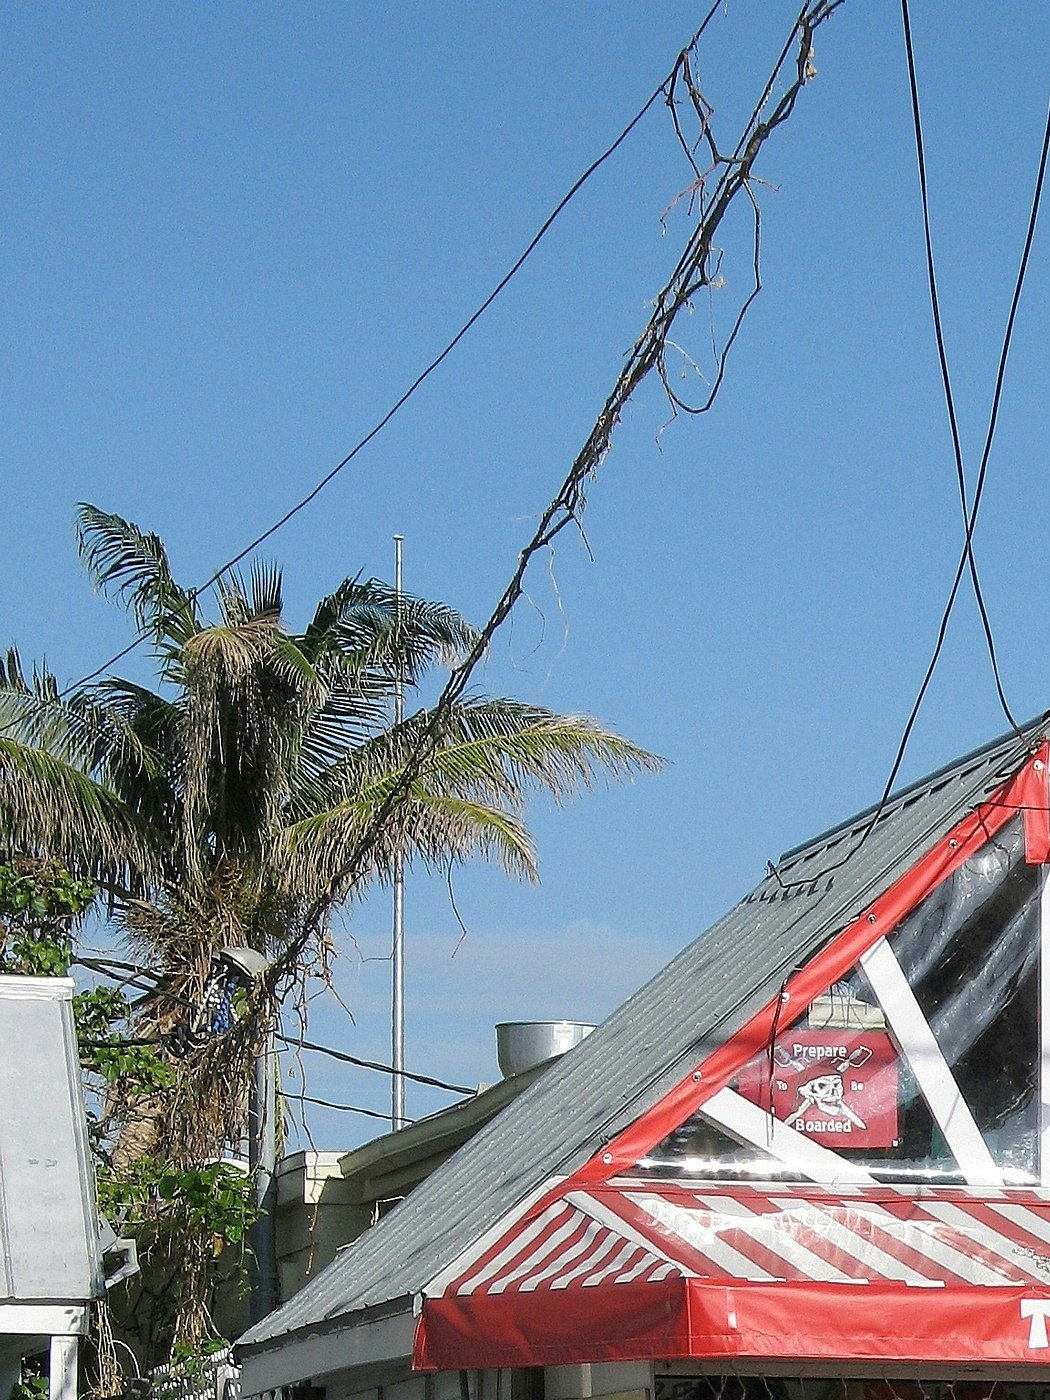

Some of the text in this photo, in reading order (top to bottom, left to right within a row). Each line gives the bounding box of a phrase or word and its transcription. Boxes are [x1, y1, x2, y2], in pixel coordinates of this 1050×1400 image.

[793, 1044, 847, 1060] Prepare
[776, 1081, 864, 1091] To Be
[795, 1119, 852, 1133] Boarded
